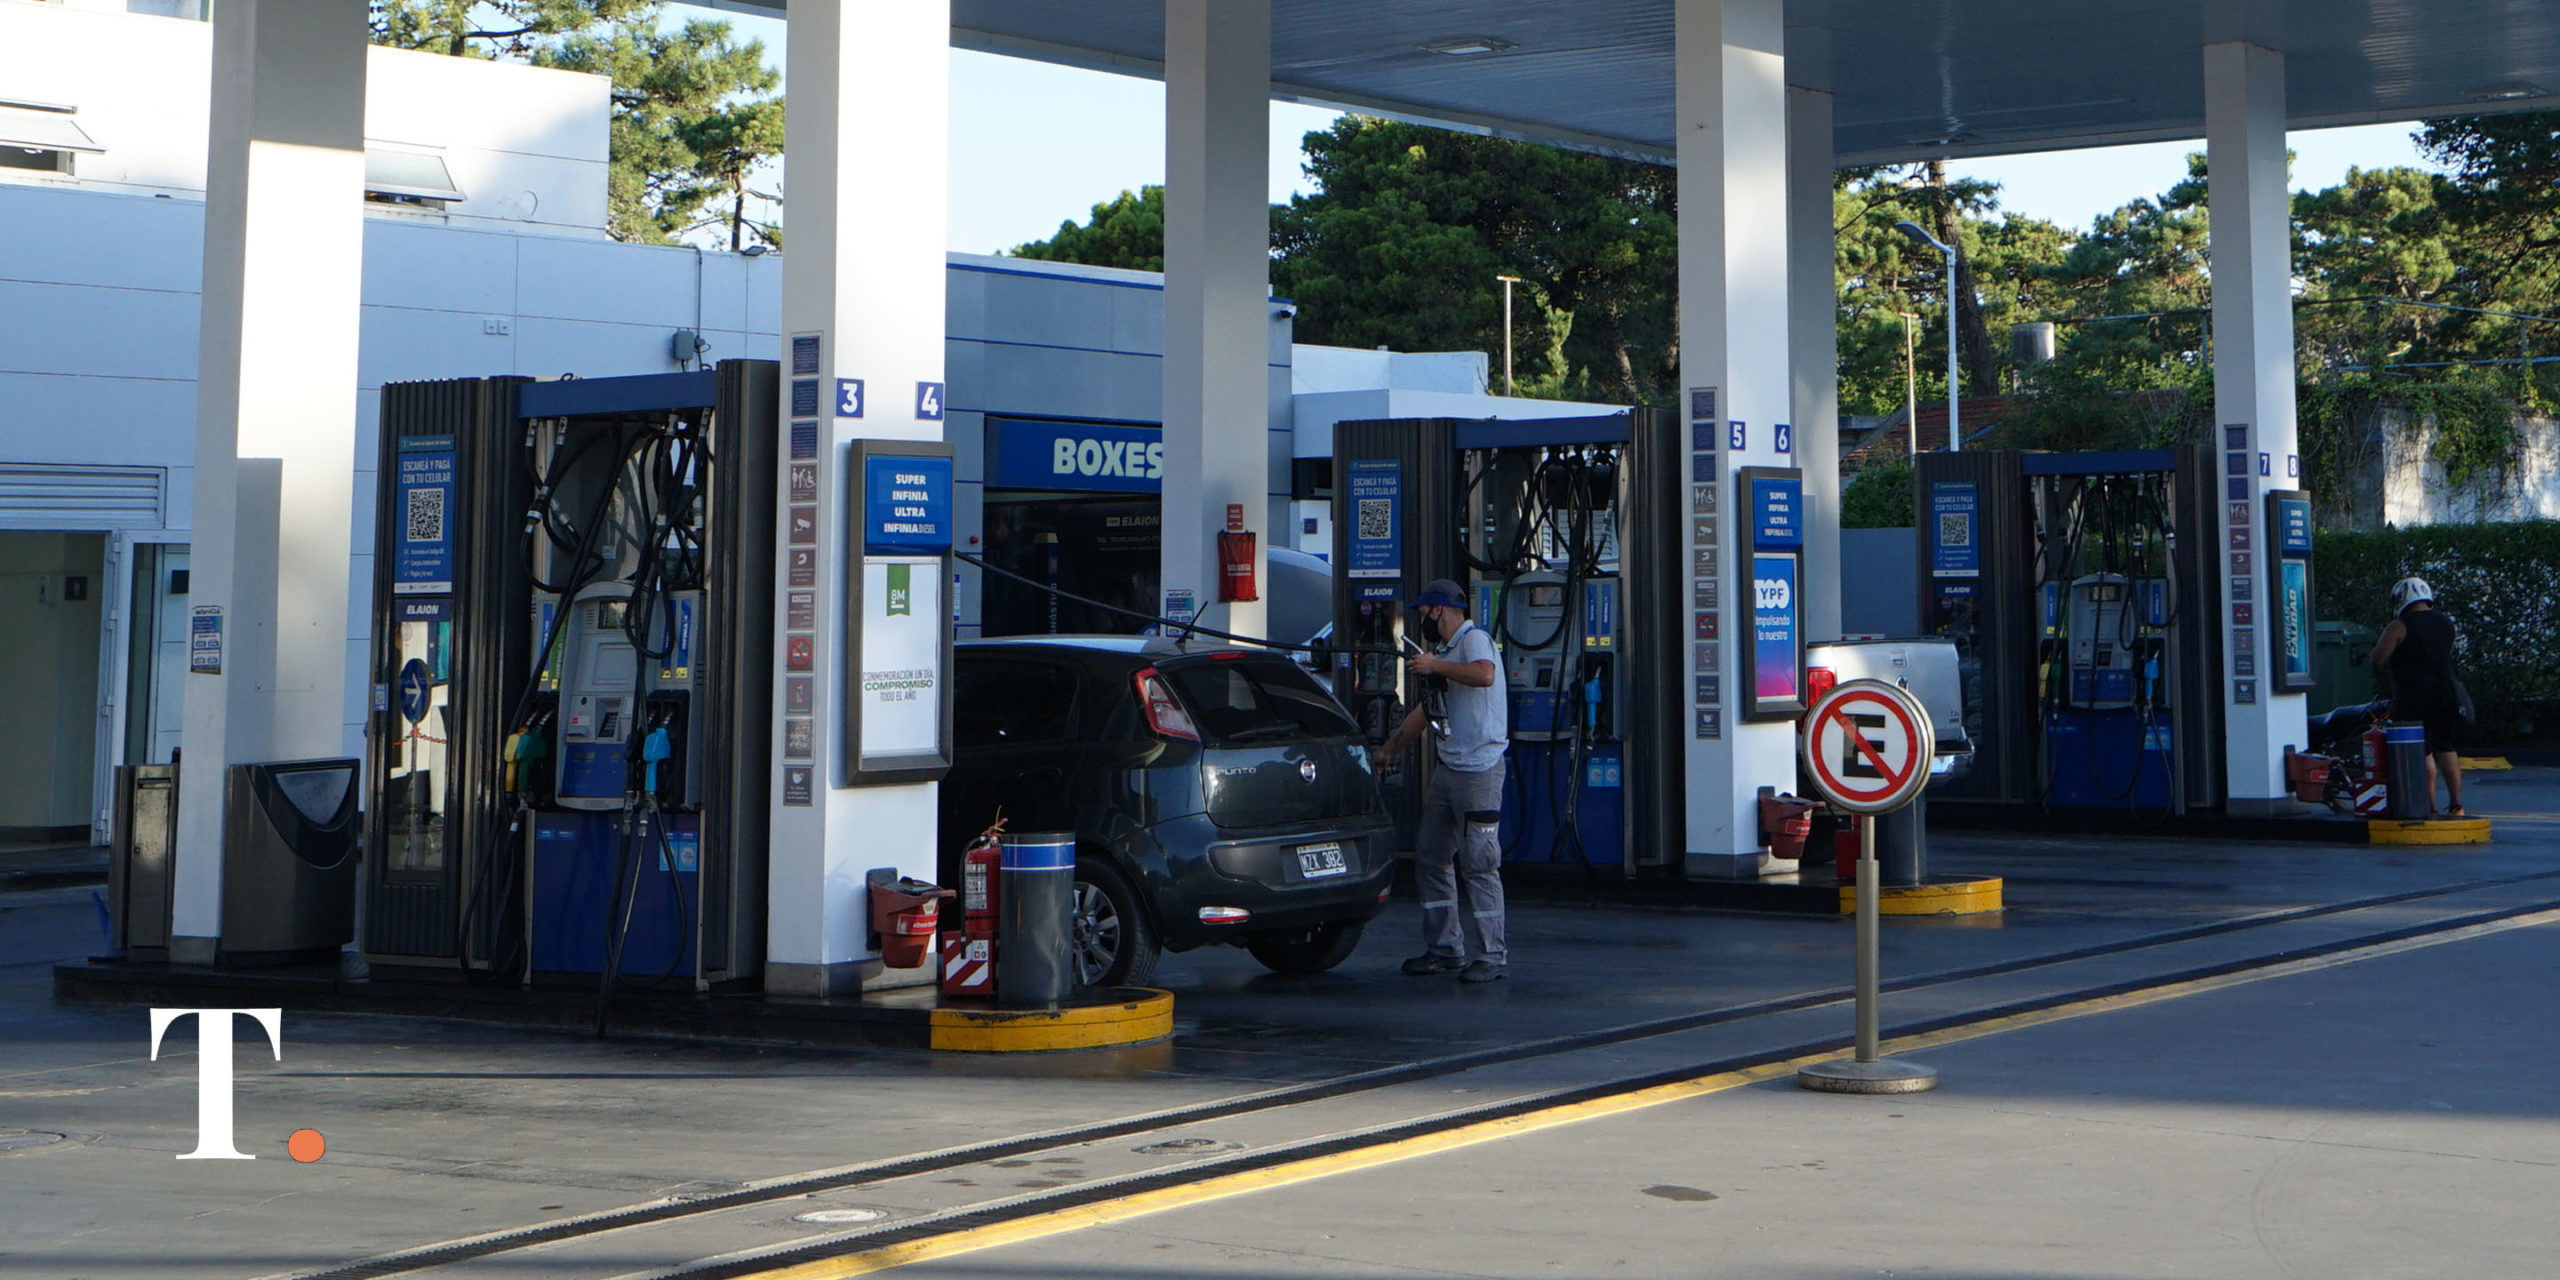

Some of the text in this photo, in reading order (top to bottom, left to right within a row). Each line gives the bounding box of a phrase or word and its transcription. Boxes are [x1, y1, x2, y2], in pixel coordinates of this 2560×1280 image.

[842, 382, 858, 413] 3
[921, 386, 939, 416] 4
[1733, 424, 1743, 447] 5
[1778, 427, 1788, 450] 6
[1053, 438, 1162, 479] BOXES
[2261, 455, 2268, 474] 7
[430, 460, 434, 470] Y
[2290, 457, 2297, 476] 8
[403, 472, 451, 484] CON TU CELULAR
[895, 474, 926, 485] SUPER
[892, 490, 928, 502] INFINIA
[894, 506, 926, 518] ULTRA
[1121, 516, 1160, 527] ELAION
[890, 589, 905, 600] 8M
[1364, 588, 1393, 596] ELAION
[1760, 588, 1784, 599] YPF
[406, 604, 439, 615] ELAION
[915, 669, 924, 679] UN
[865, 679, 934, 691] COMPROMISO
[880, 691, 895, 702] TODO
[896, 691, 904, 701] EL
[1843, 713, 1886, 779] E
[1322, 850, 1343, 868] 382
